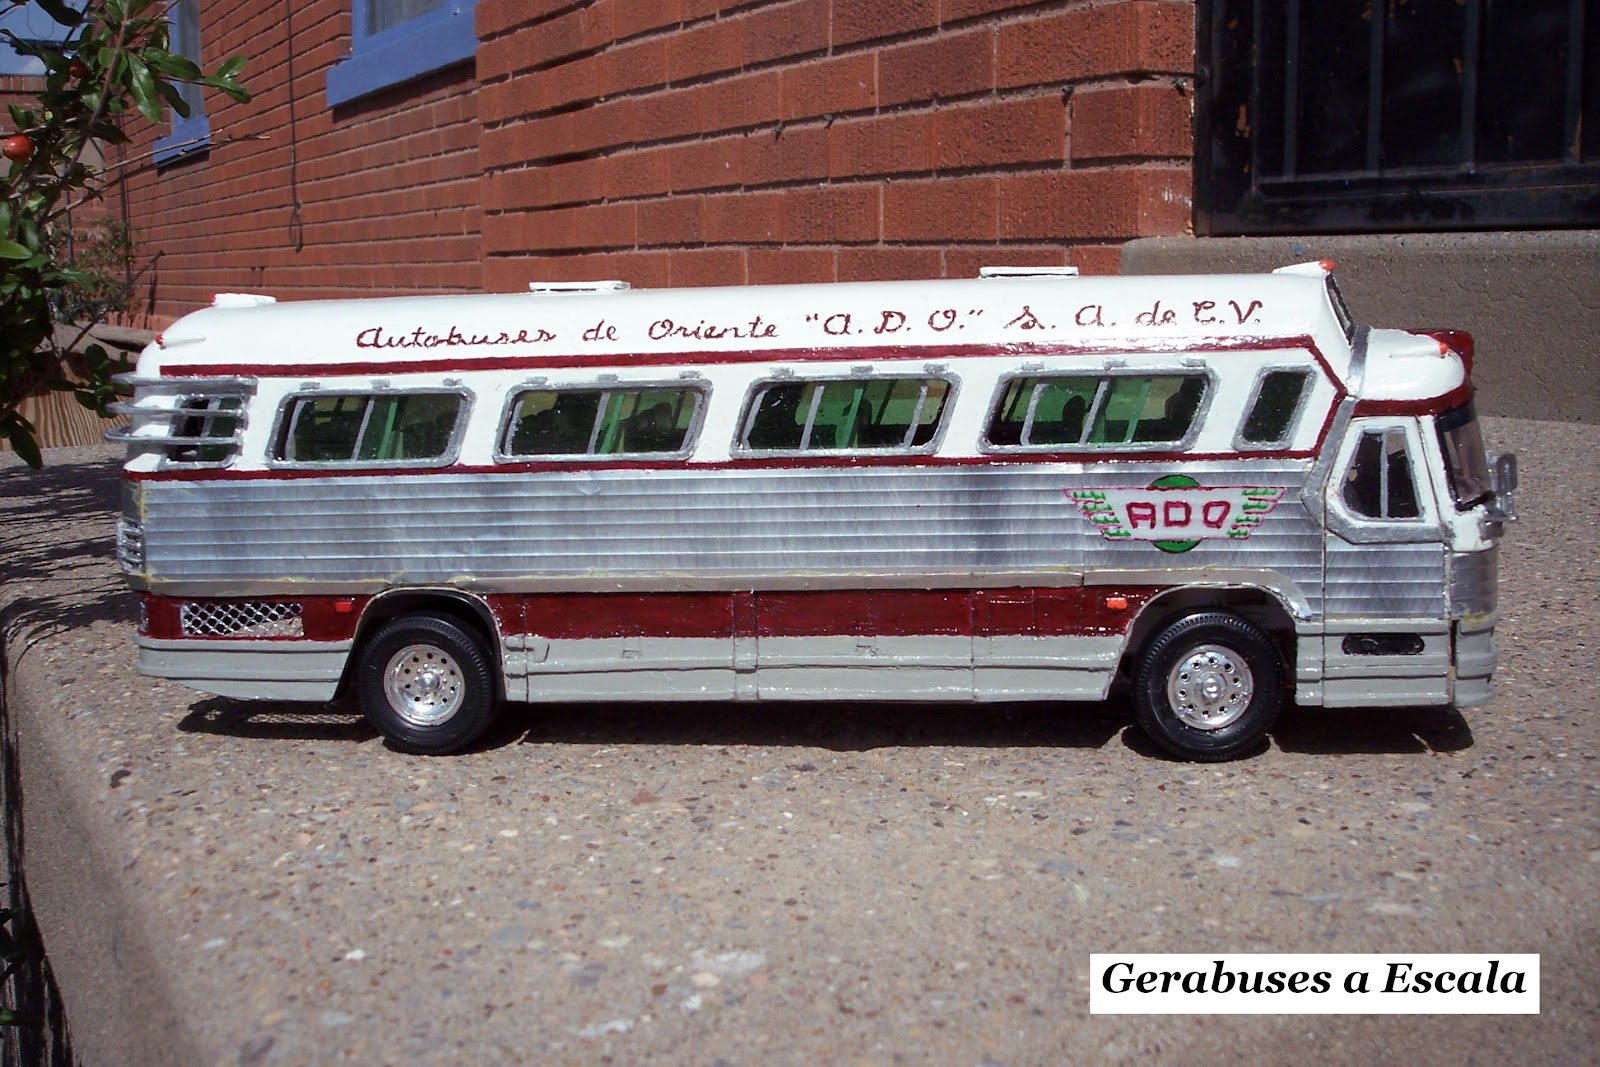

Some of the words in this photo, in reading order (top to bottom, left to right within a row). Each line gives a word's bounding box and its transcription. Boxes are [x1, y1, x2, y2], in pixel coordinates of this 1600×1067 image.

[356, 325, 557, 349] Autobuses
[582, 319, 618, 342] de
[648, 315, 778, 341] Oriente
[1136, 300, 1177, 327] de
[1126, 500, 1231, 529] ADO
